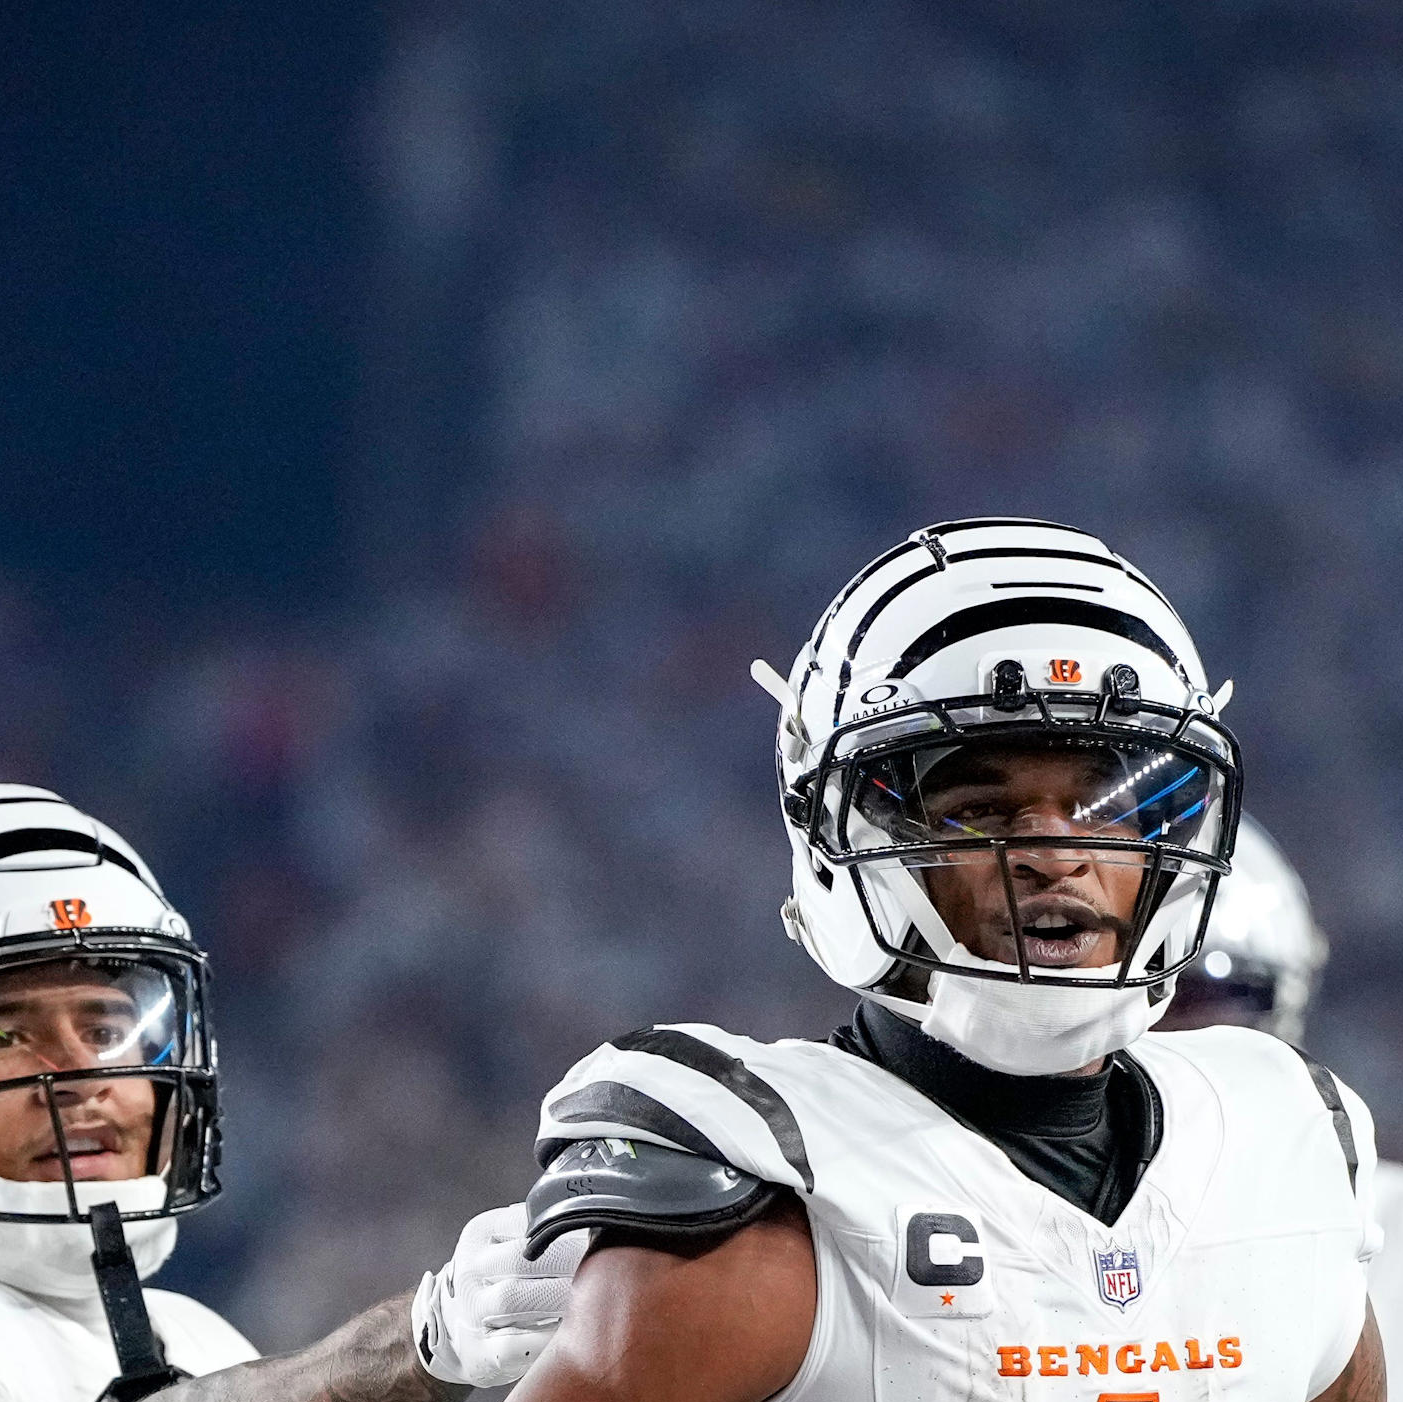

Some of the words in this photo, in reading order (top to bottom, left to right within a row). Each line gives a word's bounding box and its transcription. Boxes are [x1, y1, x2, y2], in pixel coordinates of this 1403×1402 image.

[906, 1212, 984, 1287] C
[1106, 1272, 1137, 1299] NFL
[997, 1336, 1243, 1378] BENGALS
